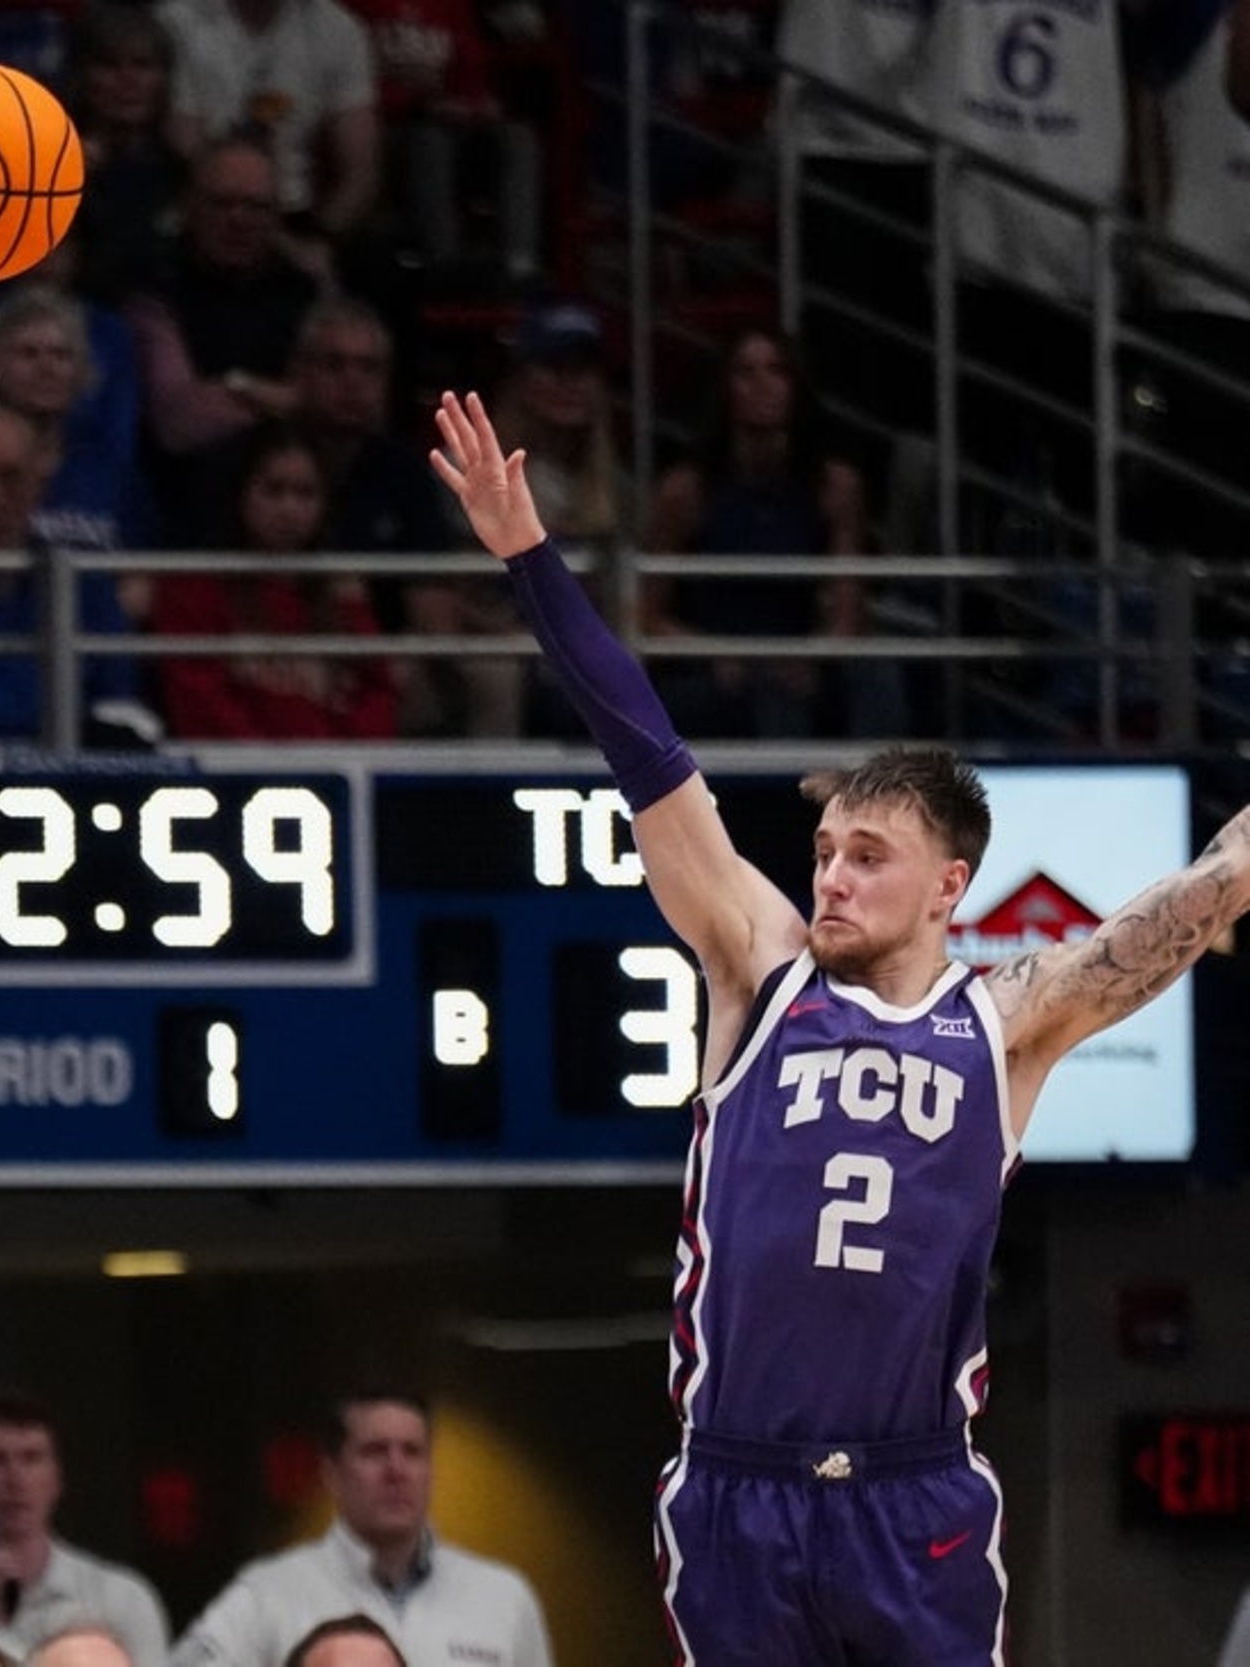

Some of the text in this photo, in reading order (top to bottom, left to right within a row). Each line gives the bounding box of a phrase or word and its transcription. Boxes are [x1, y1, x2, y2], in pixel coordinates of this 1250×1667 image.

[996, 14, 1057, 100] 6
[513, 788, 716, 886] TC
[206, 1021, 239, 1120] 1
[433, 989, 489, 1065] B
[778, 1047, 965, 1143] TCU
[814, 1152, 894, 1274] 2
